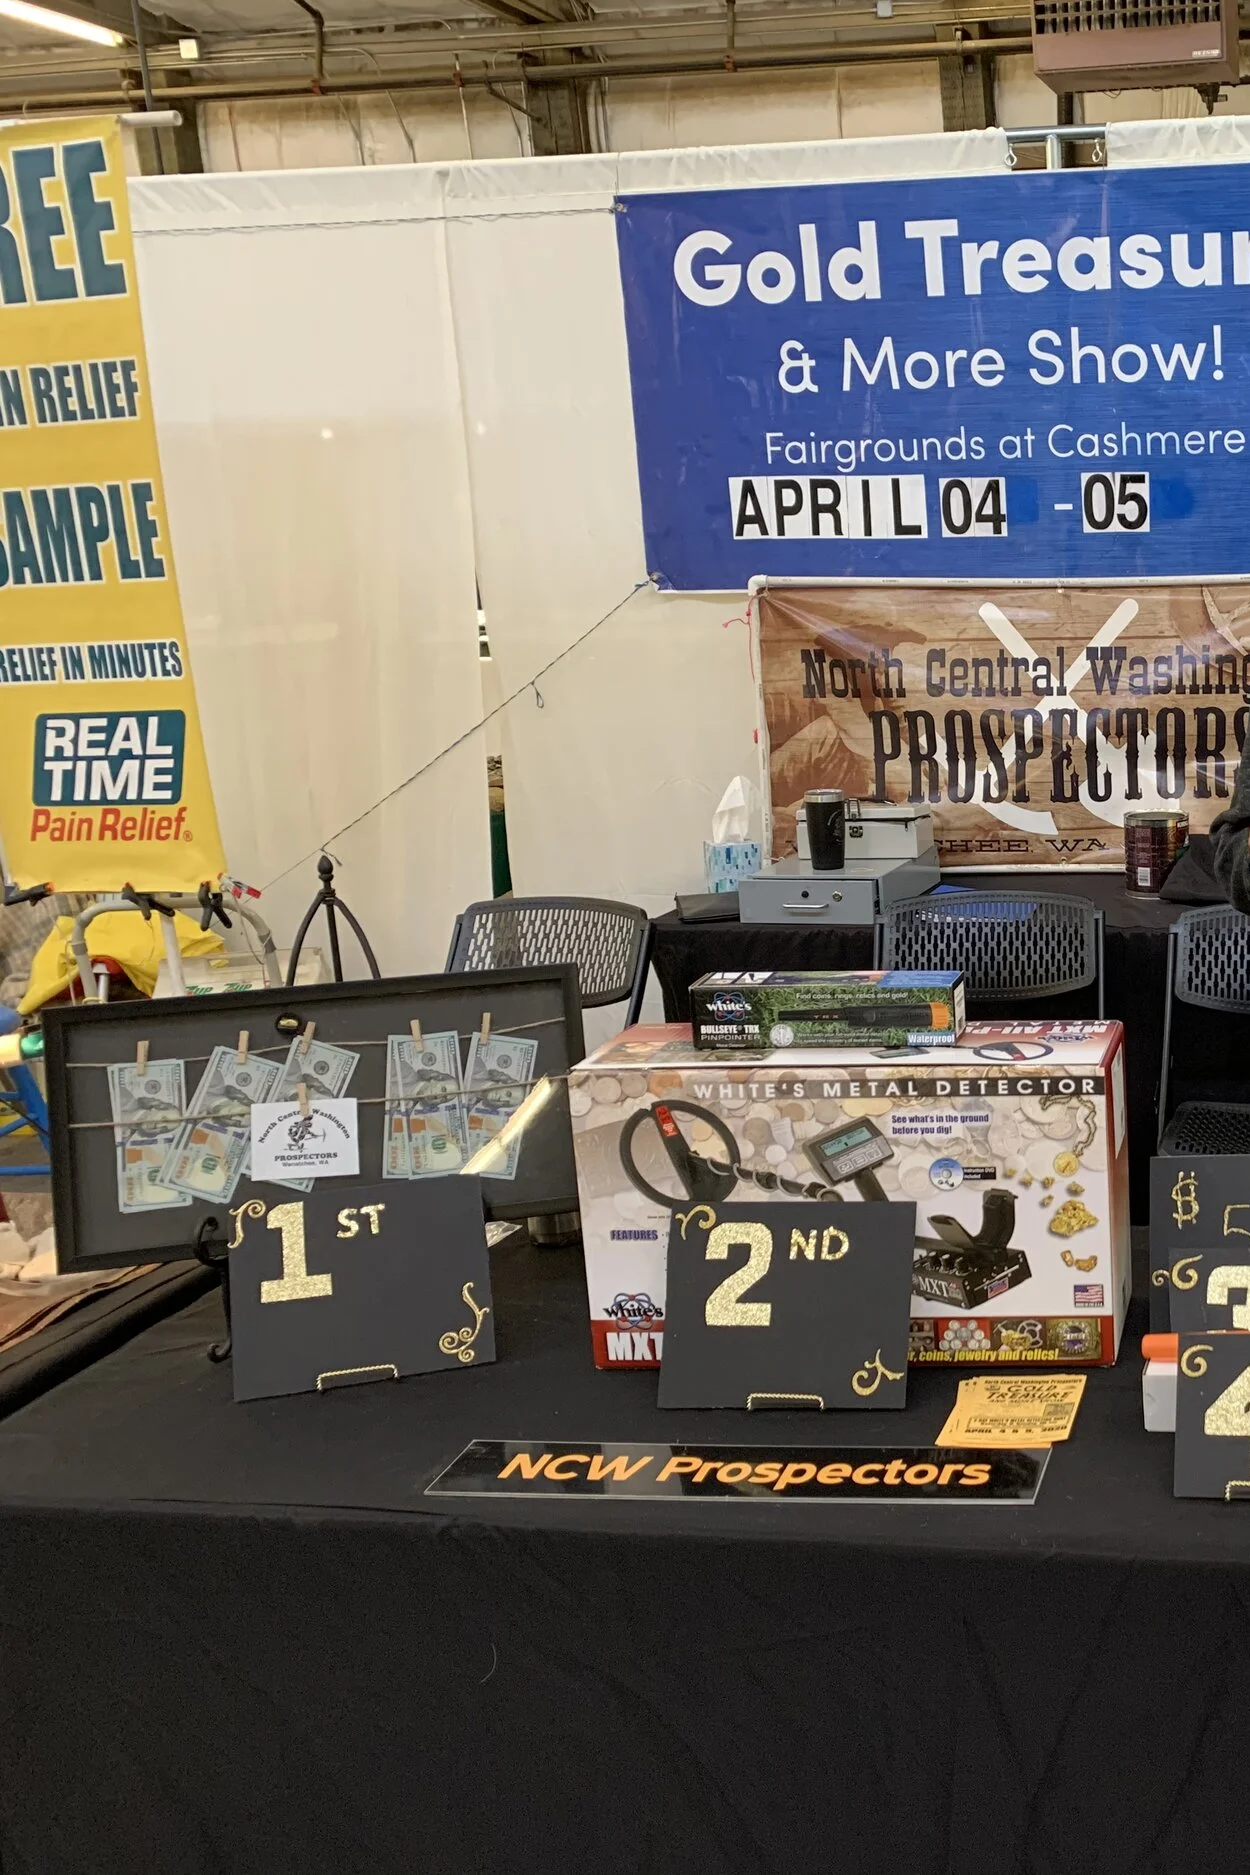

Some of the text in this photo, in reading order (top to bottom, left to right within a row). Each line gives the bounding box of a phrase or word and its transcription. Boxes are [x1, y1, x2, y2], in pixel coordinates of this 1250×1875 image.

[673, 220, 883, 306] Gold
[777, 324, 1226, 394] & More Show!
[29, 359, 138, 425] RELIEF
[765, 422, 1247, 473] Fairgrounds at Cashmere
[734, 477, 924, 538] APRIL
[941, 476, 1007, 537] 04
[0, 640, 183, 683] RELIEF IN MINUTES
[800, 645, 907, 699] North
[926, 645, 1068, 698] Central
[45, 716, 174, 757] REAL
[44, 758, 175, 801] TIME
[30, 808, 92, 843] Pain
[1045, 839, 1110, 852] WA
[700, 1024, 760, 1034] BULLSEYE TRX
[907, 1033, 955, 1045] Waterproof
[1050, 1025, 1108, 1034] MXT
[694, 1078, 1096, 1099] WHITE'S METAL DETECTOR
[258, 1108, 350, 1144] North Centr Washington
[892, 1115, 907, 1123] See
[908, 1114, 934, 1123] what's
[945, 1114, 958, 1123] the
[960, 1114, 989, 1124] ground
[892, 1126, 952, 1135] before you dig!
[274, 1152, 338, 1162] PROSPECTORS
[1170, 1170, 1200, 1230] $
[610, 1229, 659, 1241] FEATURES
[918, 1276, 949, 1297] MXT
[606, 1331, 665, 1361] MXT
[919, 1349, 952, 1361] coins,
[999, 1349, 1020, 1361] and
[1021, 1347, 1059, 1361] relics!
[986, 1391, 1073, 1400] TREASURE
[1007, 1384, 1058, 1393] GOLD
[498, 1453, 992, 1491] NCW Prospectors
